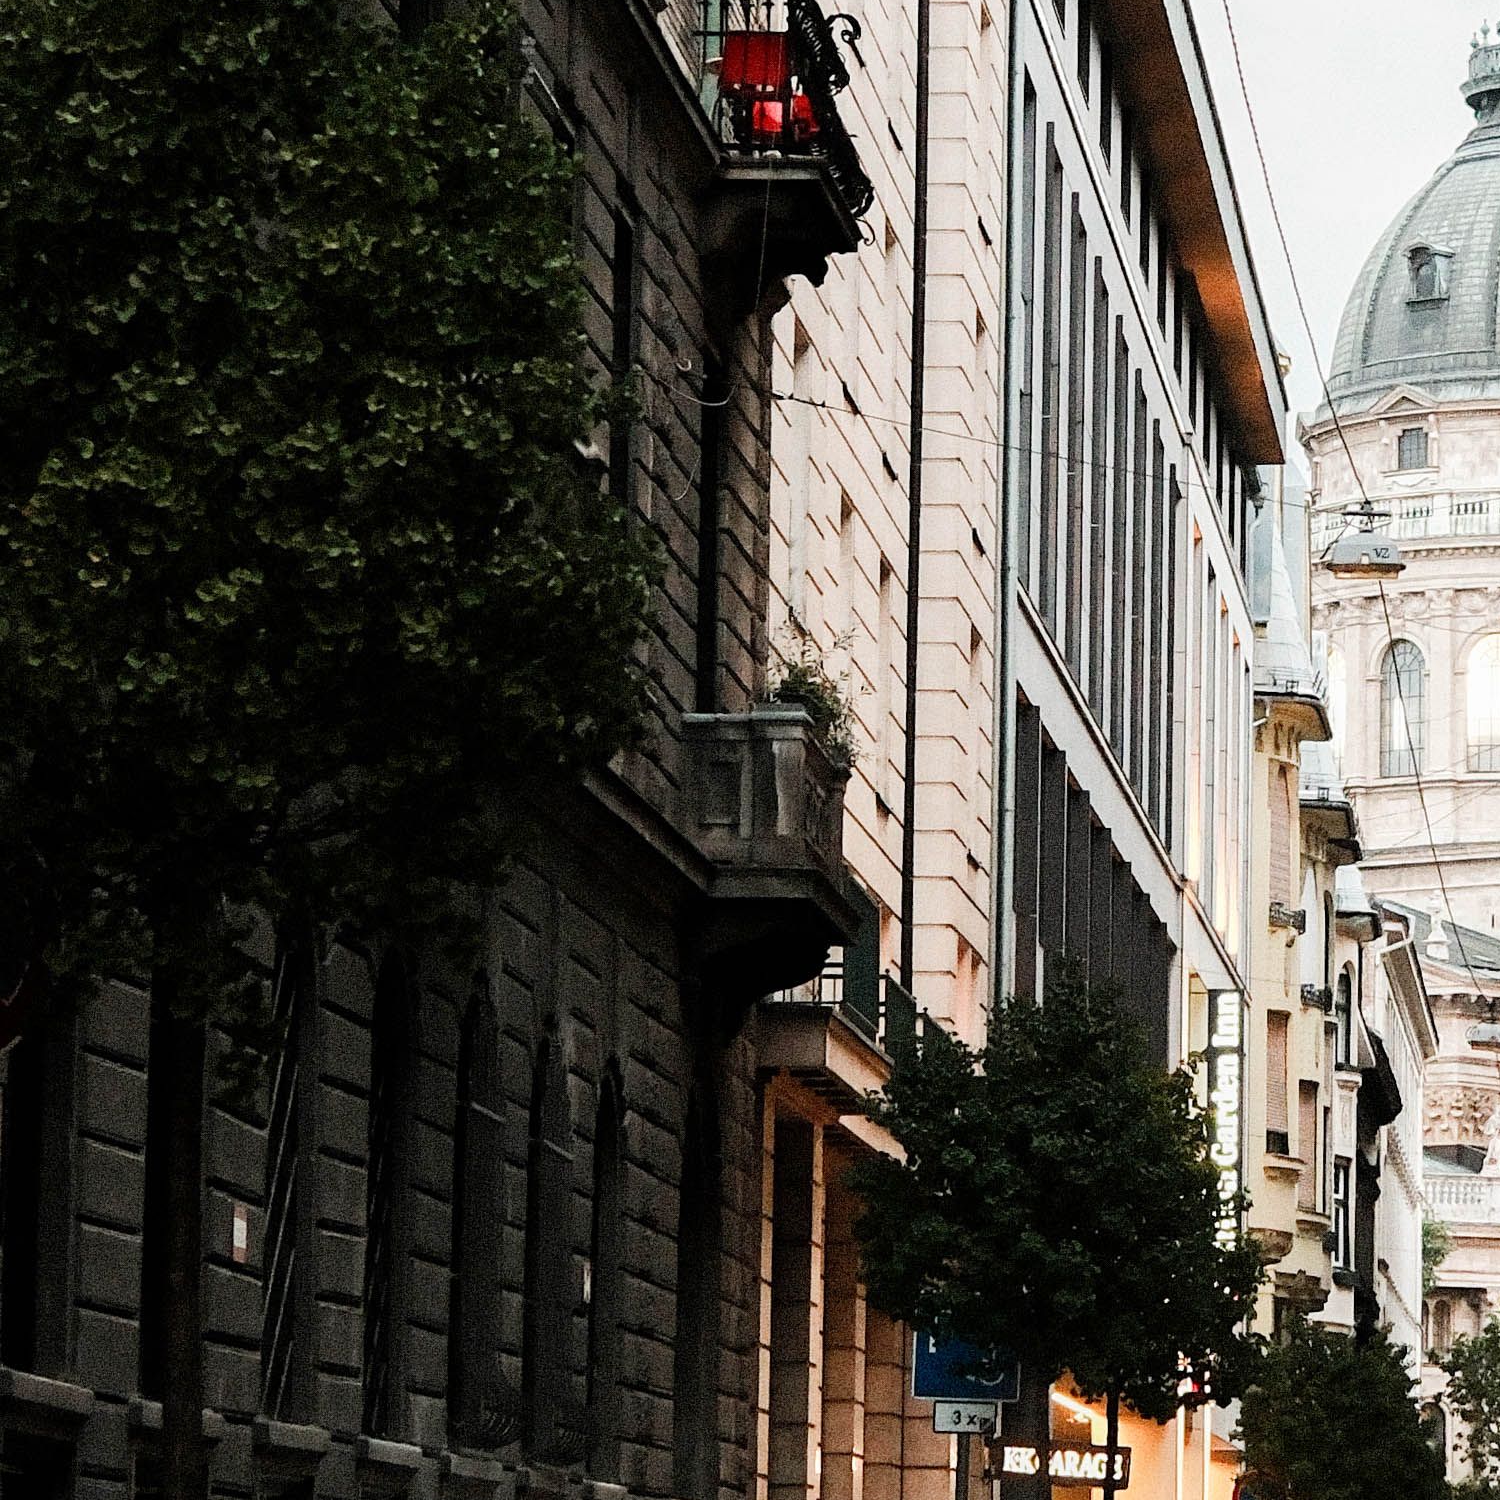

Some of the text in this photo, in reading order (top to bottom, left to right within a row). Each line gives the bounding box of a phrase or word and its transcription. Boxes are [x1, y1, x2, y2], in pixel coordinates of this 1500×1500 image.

[1211, 991, 1241, 1048] Inn
[1210, 1053, 1240, 1166] Garden
[952, 1409, 962, 1426] 3
